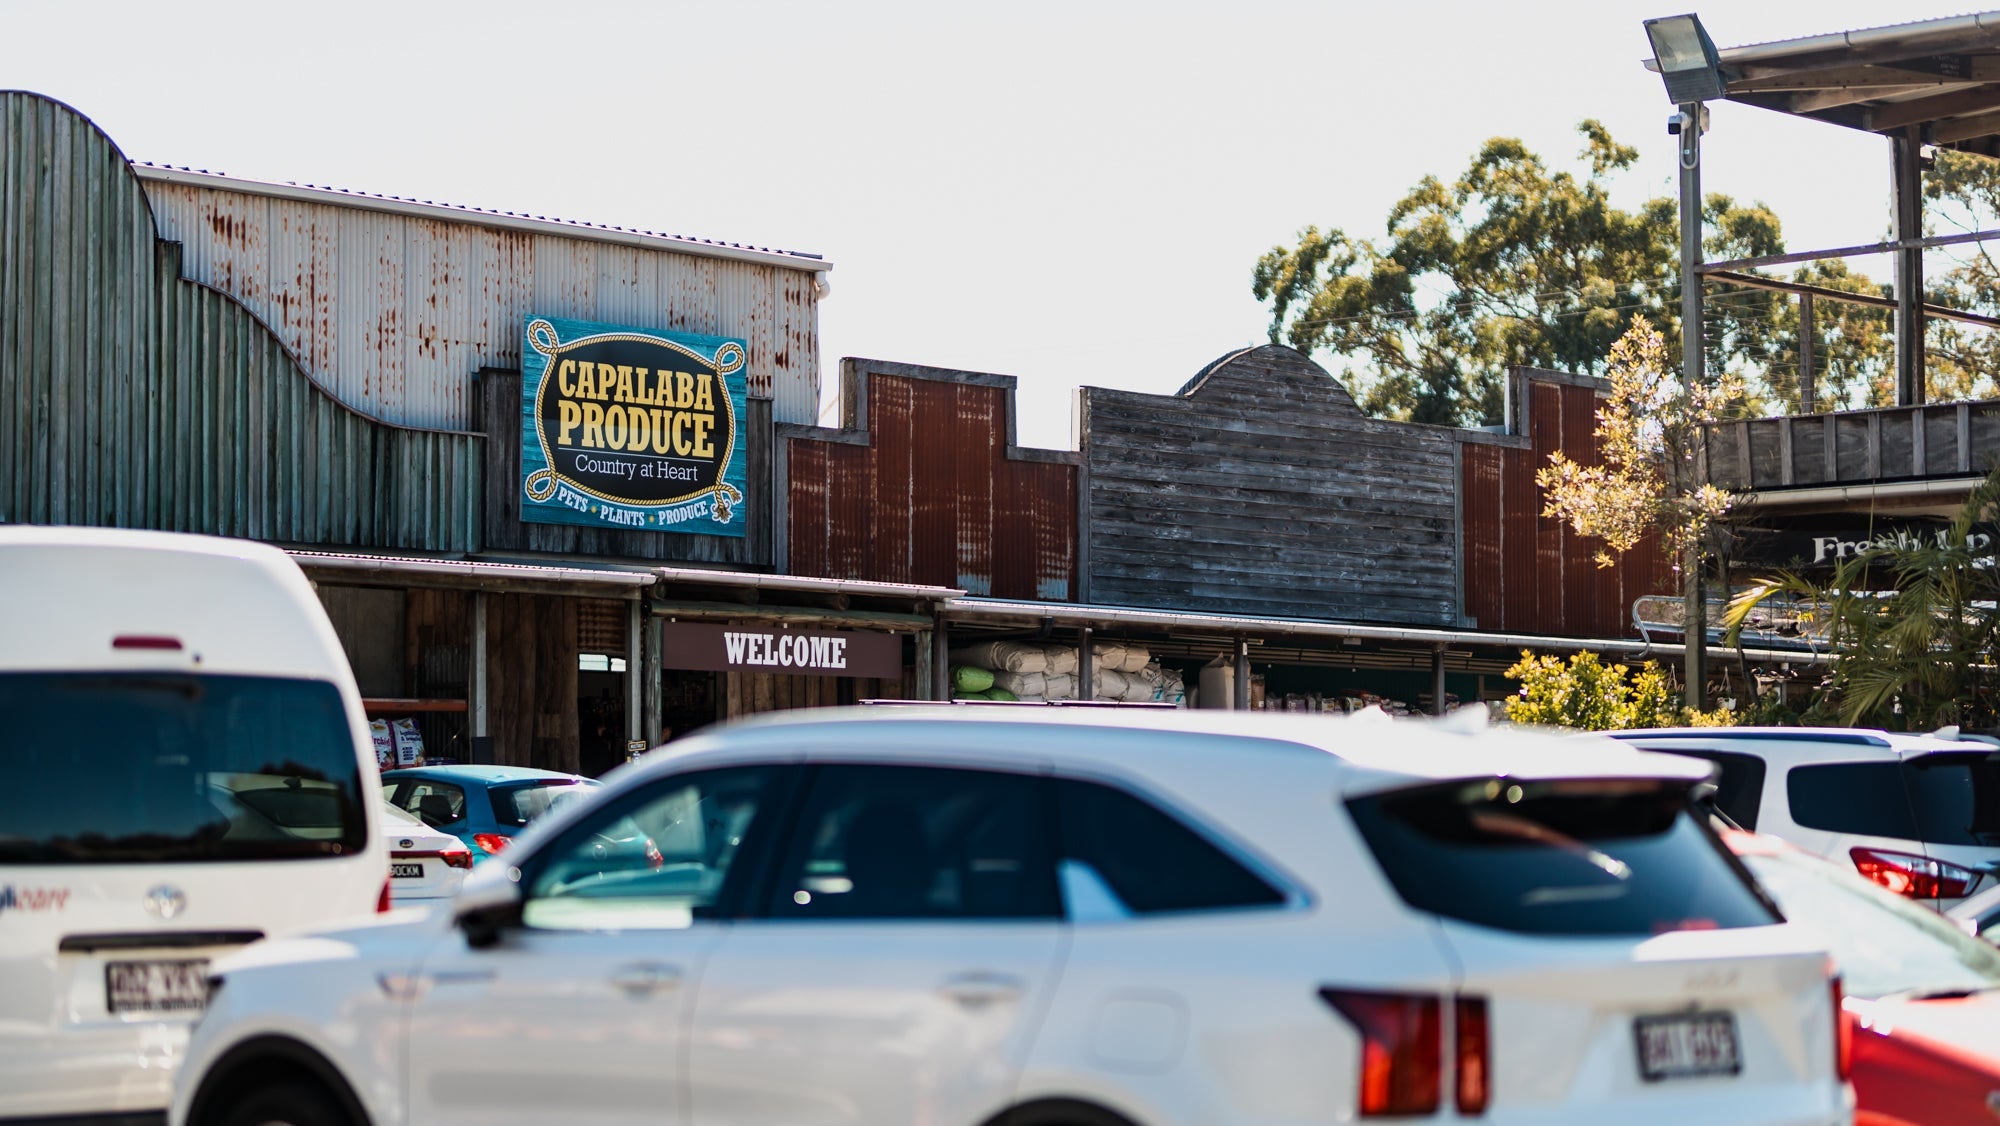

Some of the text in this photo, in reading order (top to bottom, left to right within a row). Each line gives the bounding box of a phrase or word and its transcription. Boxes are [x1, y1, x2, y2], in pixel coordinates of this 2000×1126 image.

[558, 359, 714, 411] CAPALABA
[557, 400, 715, 458] PRODUCE
[575, 454, 698, 481] Country at Heart
[557, 486, 709, 527] PETS PLANTS PRODUCE
[724, 632, 846, 669] WELCOME
